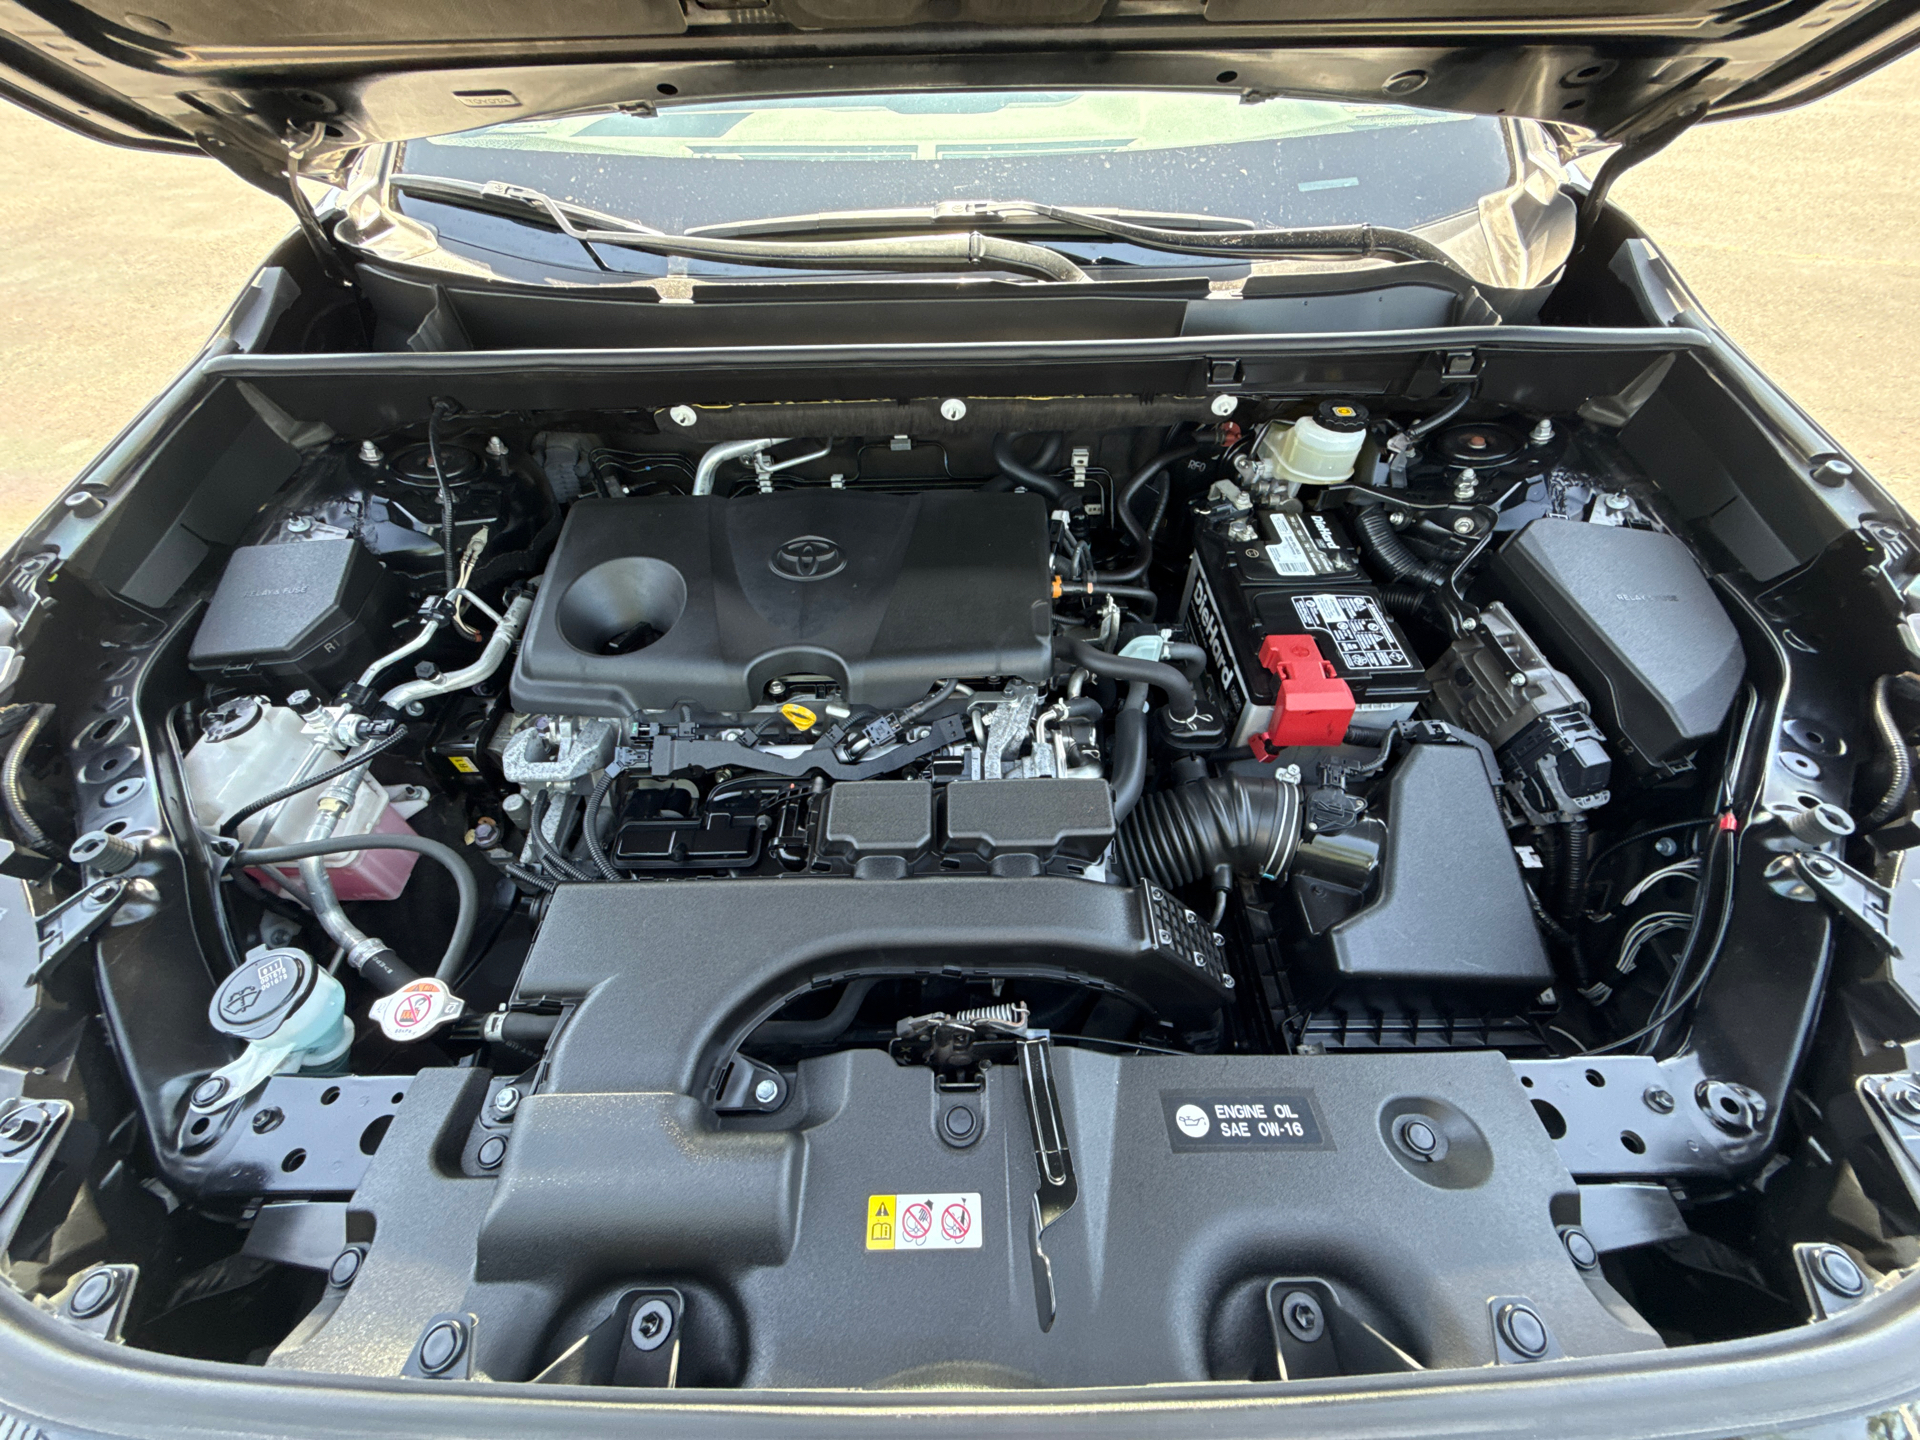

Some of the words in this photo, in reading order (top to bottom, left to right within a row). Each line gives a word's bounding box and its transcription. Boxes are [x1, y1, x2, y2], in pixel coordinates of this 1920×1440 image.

[465, 97, 512, 105] TOYOTA
[1310, 515, 1341, 550] DieHard
[281, 584, 310, 595] FUSE
[1615, 592, 1646, 602] RELAY
[1193, 579, 1235, 691] DieHard
[1214, 1104, 1267, 1119] ENGINE
[1273, 1104, 1299, 1119] OIL
[1220, 1121, 1251, 1137] SAE
[1257, 1121, 1304, 1137] 0W-16
